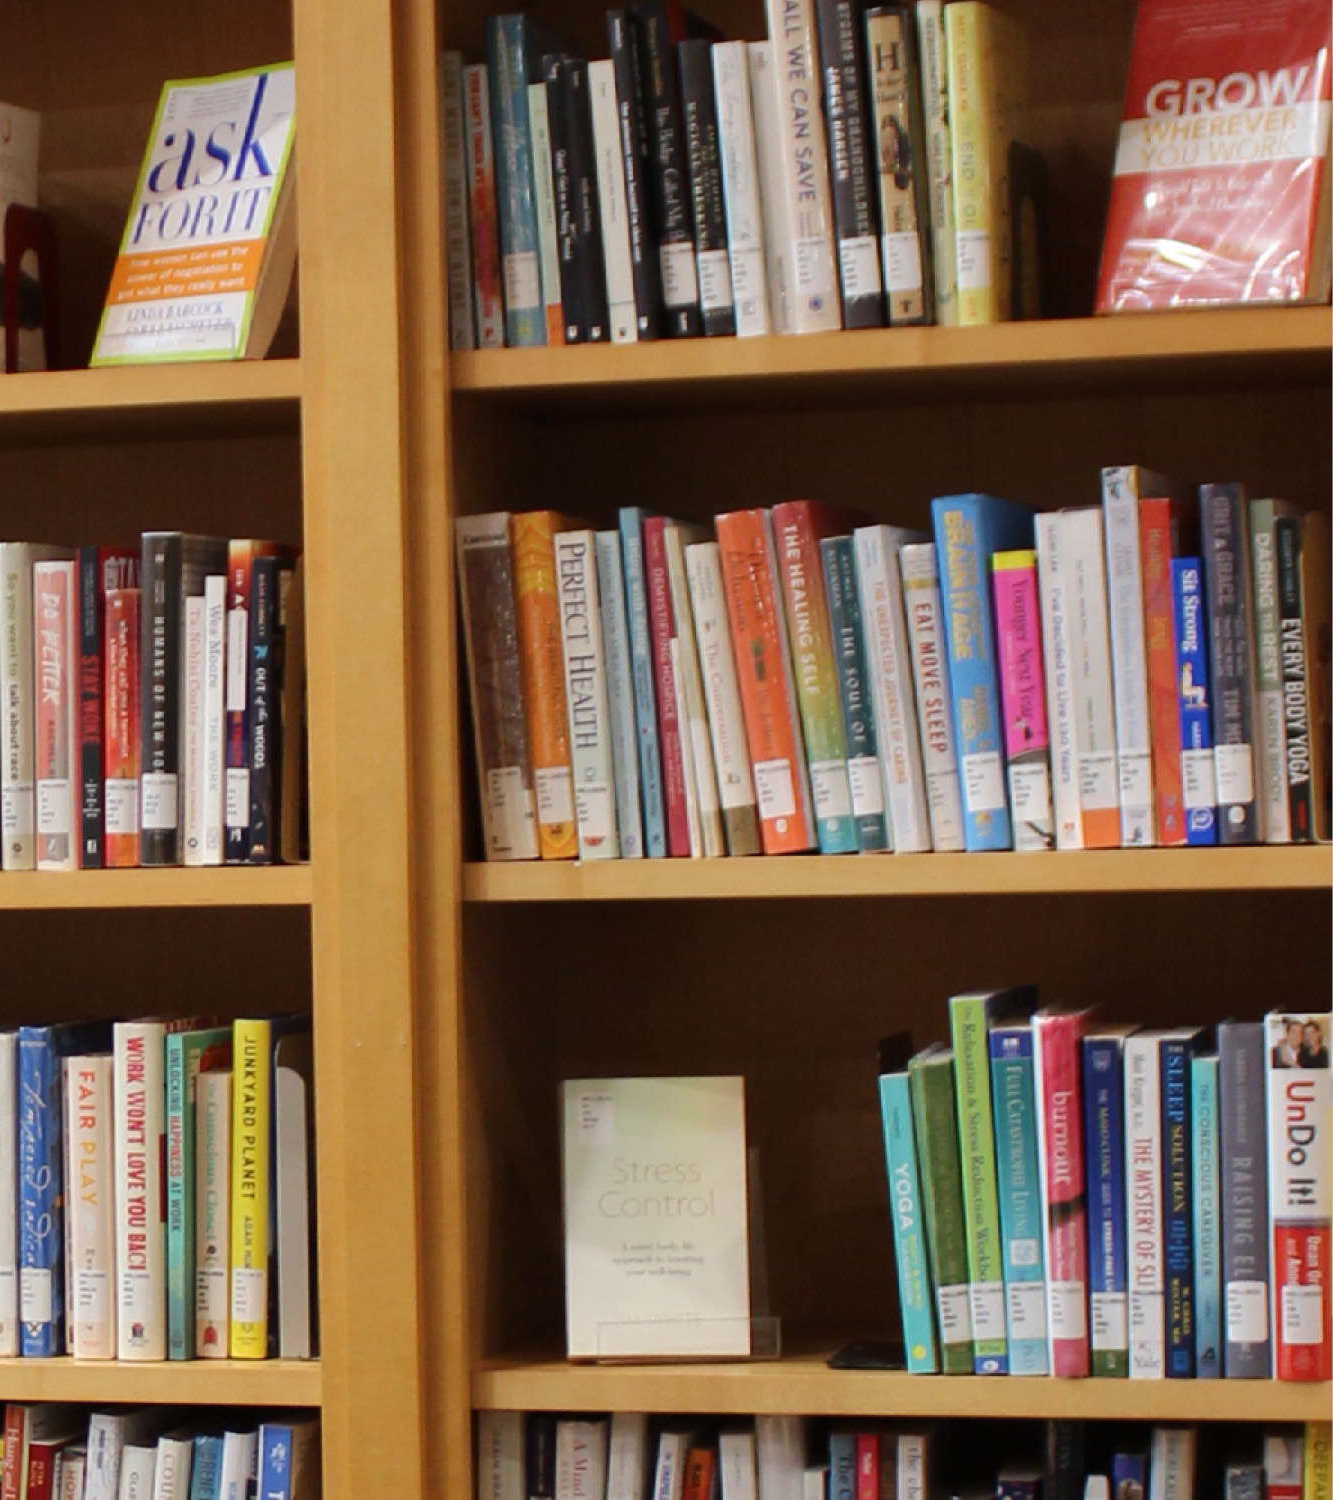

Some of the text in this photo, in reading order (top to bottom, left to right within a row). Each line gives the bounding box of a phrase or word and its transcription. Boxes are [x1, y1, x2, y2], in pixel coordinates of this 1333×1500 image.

[789, 46, 806, 80] WE
[1145, 66, 1309, 117] GROW
[148, 72, 289, 194] ask
[792, 89, 812, 140] CAN
[827, 66, 848, 180] JAMES HANSEN
[1141, 135, 1296, 168] YOU WORK
[1143, 108, 1298, 143] WHEREVER
[132, 187, 273, 244] FOR IT
[794, 147, 816, 203] SAVE
[231, 246, 249, 257] the
[41, 592, 60, 704] DO BETTER
[208, 604, 221, 688] Wes Moore
[559, 542, 598, 749] PERFECT HEALTH
[784, 523, 818, 695] THE HEALING SELF
[1180, 569, 1198, 653] Sit Strong
[1255, 532, 1277, 681] DARING TO REST
[82, 654, 98, 694] STAY
[153, 616, 164, 741] HUMANS OF NEW
[915, 603, 947, 753] EAT MOVE SLEEP
[1281, 618, 1309, 785] EVERY BODY YOGA
[8, 684, 20, 780] talk about race
[83, 699, 99, 744] WOKE
[962, 1023, 983, 1094] Relaxation
[79, 1070, 97, 1207] FAIR PLAY
[127, 1036, 146, 1228] WORK WON'T LOVE YOU
[243, 1035, 257, 1200] JUNKYARD PLANET
[1051, 1091, 1072, 1185] burnout
[1168, 1055, 1186, 1213] SLEEP SOLUTION
[1286, 1081, 1316, 1206] UnDo It!
[598, 1189, 716, 1219] Control
[612, 1156, 702, 1185] Stress
[894, 1162, 914, 1231] YOGA
[969, 1112, 987, 1226] Stress Reduction
[1134, 1137, 1154, 1259] THE MYSTERY OF
[572, 1456, 588, 1497] Mind
